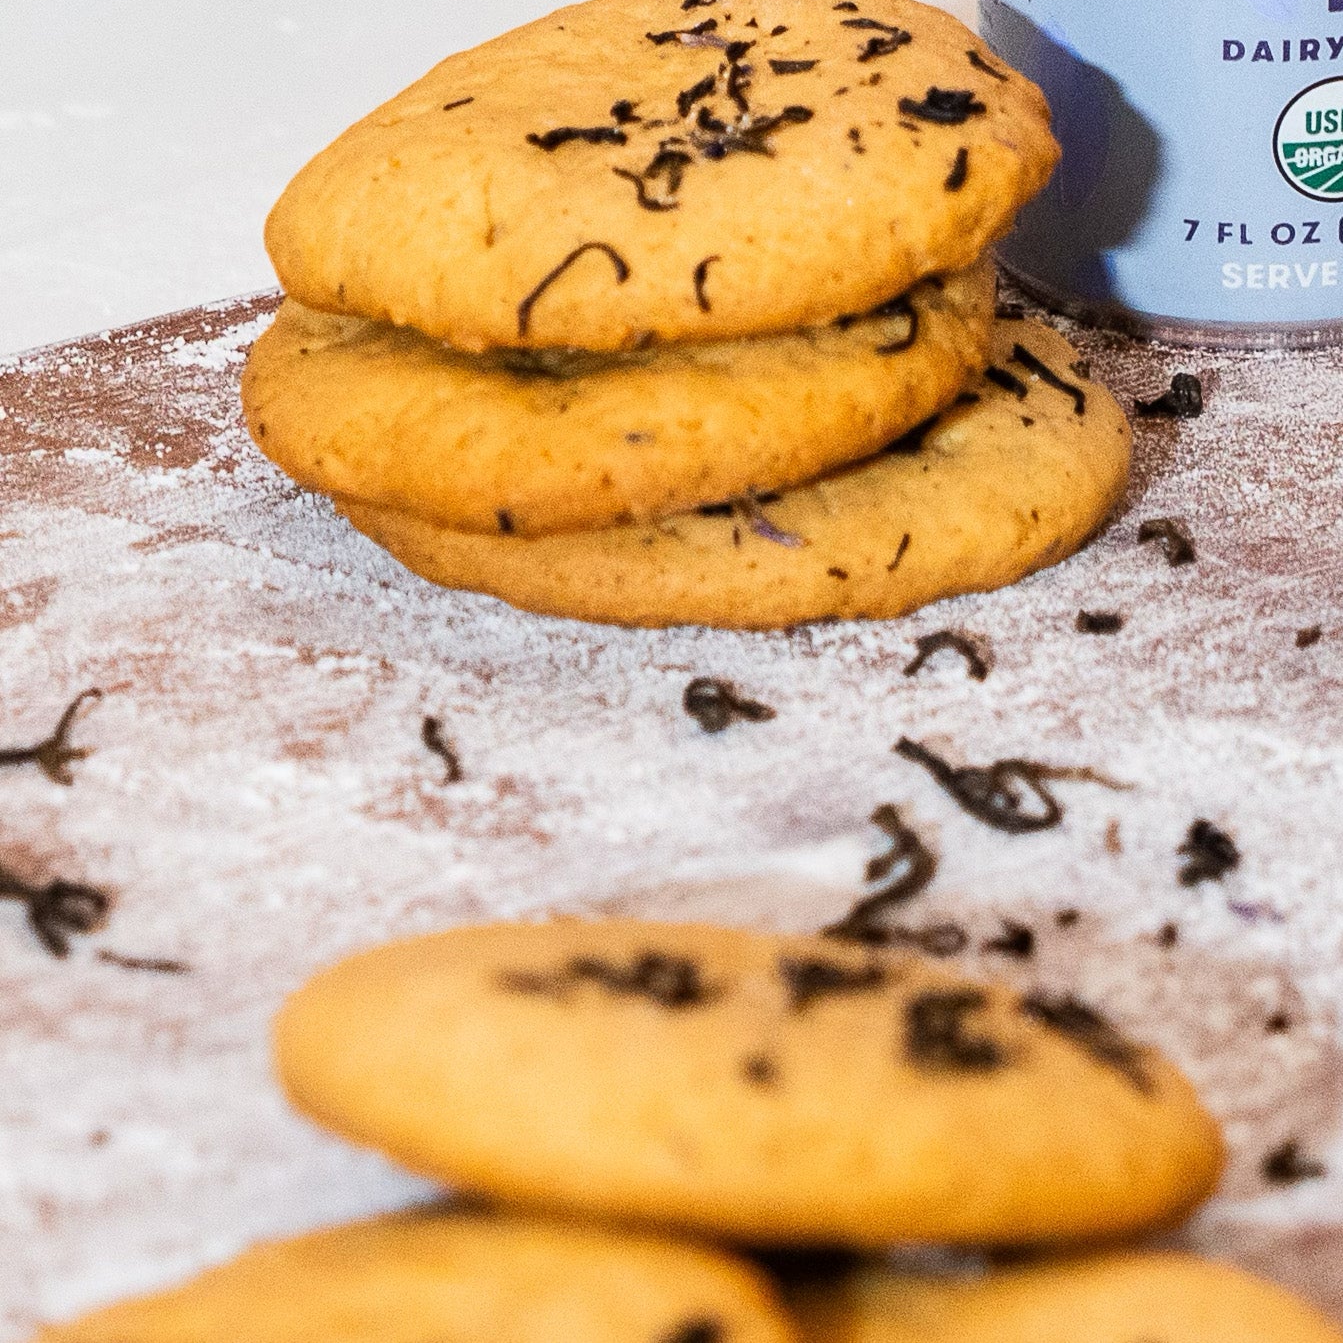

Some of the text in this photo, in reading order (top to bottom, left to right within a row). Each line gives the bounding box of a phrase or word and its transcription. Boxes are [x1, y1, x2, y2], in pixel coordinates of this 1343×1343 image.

[1183, 219, 1200, 242] 7
[1217, 222, 1253, 245] FL
[1270, 221, 1321, 246] OZ
[1221, 259, 1339, 290] SERVE
